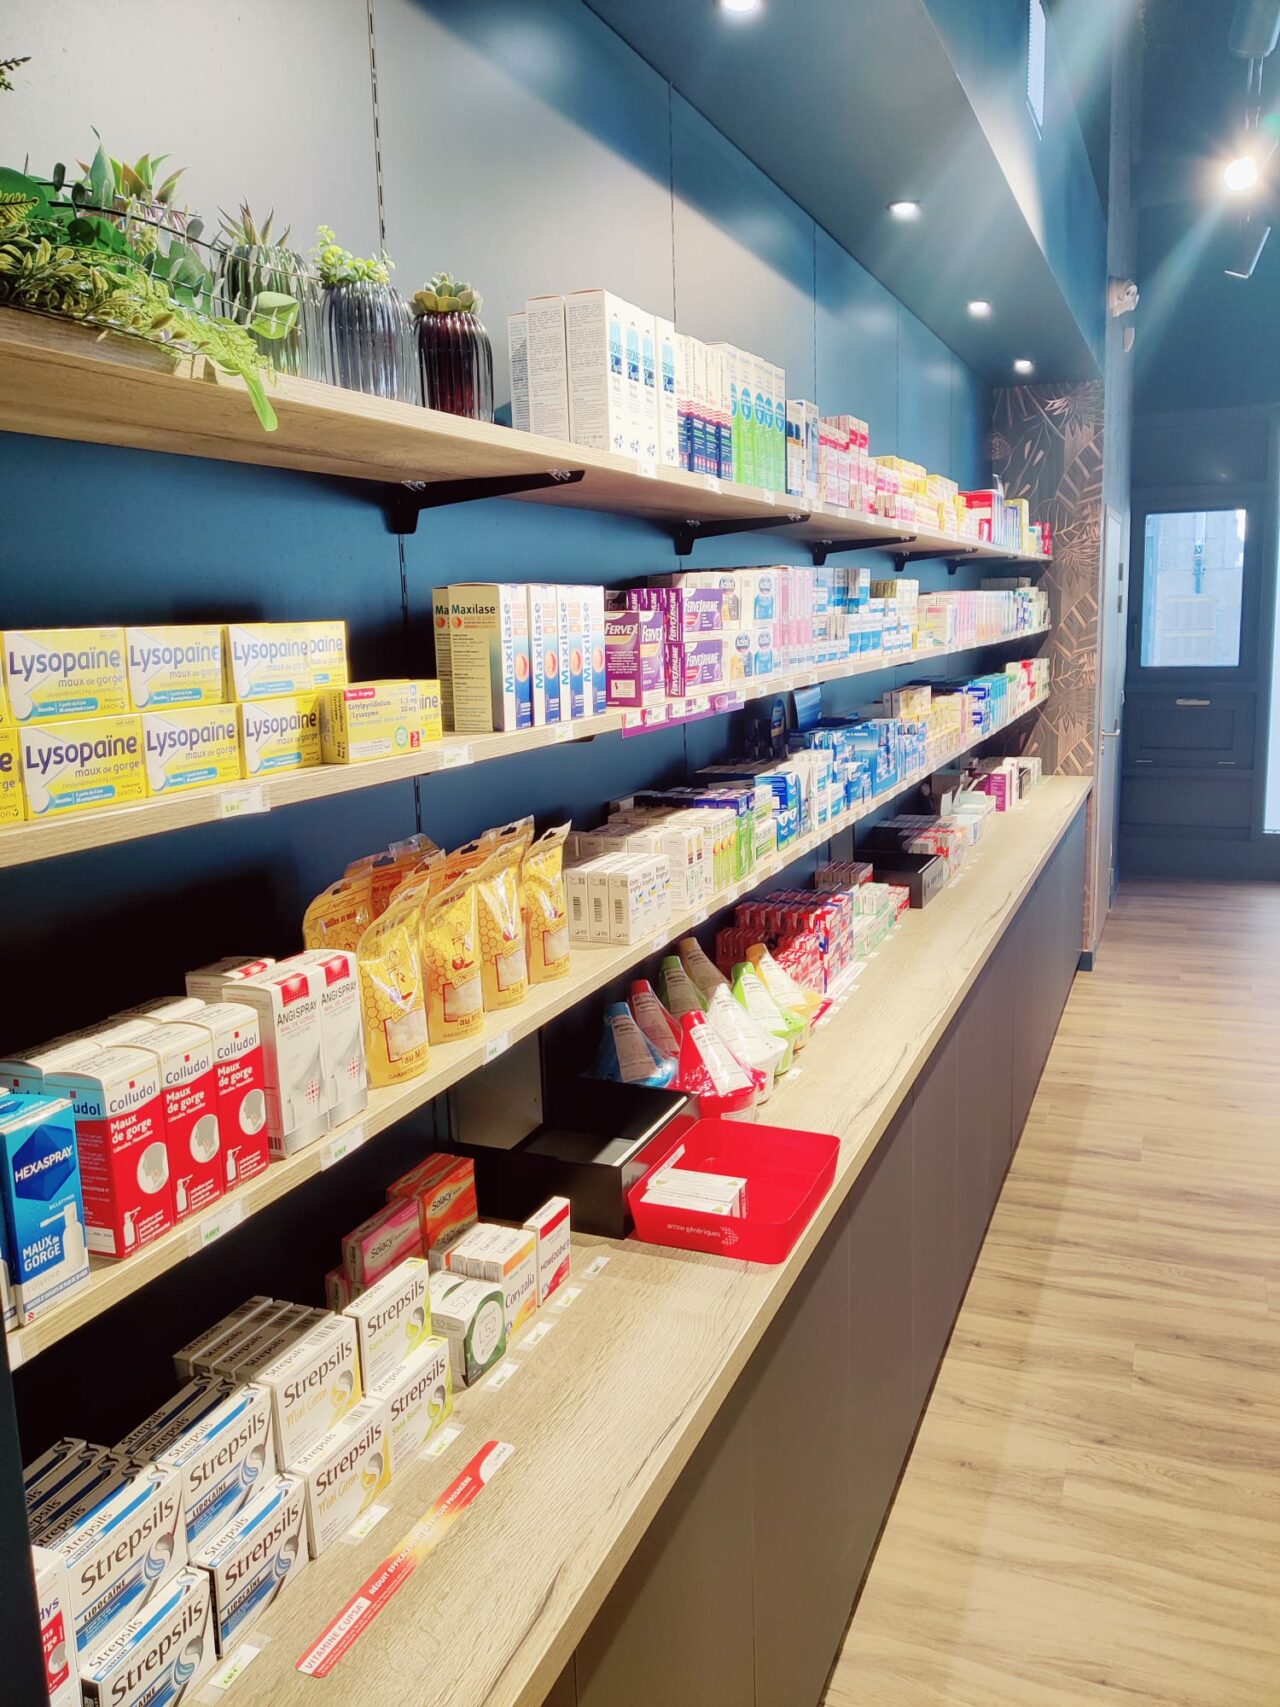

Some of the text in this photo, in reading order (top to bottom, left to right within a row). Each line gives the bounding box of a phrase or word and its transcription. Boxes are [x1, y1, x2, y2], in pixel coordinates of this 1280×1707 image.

[452, 604, 496, 615] Maxilase
[560, 602, 569, 685] Maxilase
[582, 602, 592, 682] Maxilase
[606, 623, 638, 636] FERVEX
[642, 624, 663, 642] FERVEX
[130, 642, 220, 673] Lysopaïne
[234, 638, 309, 666] Lysopaïne
[503, 603, 514, 692] Maxilase
[533, 602, 544, 689] Maxilase
[9, 646, 121, 682] Lysopaïne
[58, 674, 123, 688] maux de gorge
[146, 722, 236, 756] Lysopaïne
[246, 711, 316, 742] Lysopaïne
[26, 735, 138, 775] Lysopaïne
[185, 750, 206, 761] maux
[216, 744, 236, 758] gorge
[75, 759, 140, 778] maux de gorge
[323, 981, 357, 1006] ANGISPRAY
[276, 999, 317, 1028] ANGISPRAY
[217, 1034, 257, 1060] Colludol
[166, 1056, 210, 1085] Colludol
[217, 1061, 240, 1078] Maux
[218, 1066, 252, 1087] de gorge
[74, 1101, 102, 1116] udol
[109, 1082, 156, 1114] Colludol
[166, 1087, 191, 1104] Maux
[168, 1090, 204, 1114] de gorge
[110, 1114, 138, 1134] Maux
[112, 1131, 124, 1144] de
[125, 1118, 152, 1142] gorge
[15, 1144, 73, 1183] HEXASPRAY
[432, 1192, 452, 1212] Solacy
[666, 1222, 686, 1232] arrow
[22, 1234, 60, 1260] MAUX de
[24, 1244, 62, 1272] GORGE
[370, 1236, 394, 1259] Solacy
[350, 1282, 384, 1310] Strepsils
[505, 1272, 535, 1310] Coryzalia
[367, 1278, 425, 1338] Strepsils
[222, 1334, 264, 1365] Strepsils
[245, 1338, 285, 1368] Strepsils
[264, 1346, 306, 1378] Strepsils
[284, 1340, 352, 1408] Strepsils
[374, 1363, 407, 1393] Strepsils
[390, 1356, 446, 1422] Strepsils
[122, 1409, 166, 1448] Strepsils
[144, 1416, 190, 1453] Strepsils
[168, 1420, 213, 1460] Strepsils
[189, 1410, 265, 1493] Strepsils
[298, 1431, 336, 1466] Strepsils
[316, 1422, 382, 1497] Strepsils
[318, 1488, 338, 1513] Miel
[58, 1510, 113, 1558] Strepsils
[81, 1494, 174, 1596] Strepsils
[205, 1516, 248, 1558] Strepsils
[224, 1500, 299, 1592] Strepsils
[367, 1570, 390, 1596] RÉDUIT
[445, 1474, 473, 1505] PASSAGÈRE
[88, 1617, 142, 1670] Strepsils
[304, 1603, 363, 1670] VITAMINE C UPSA
[111, 1598, 204, 1707] Strepsils
